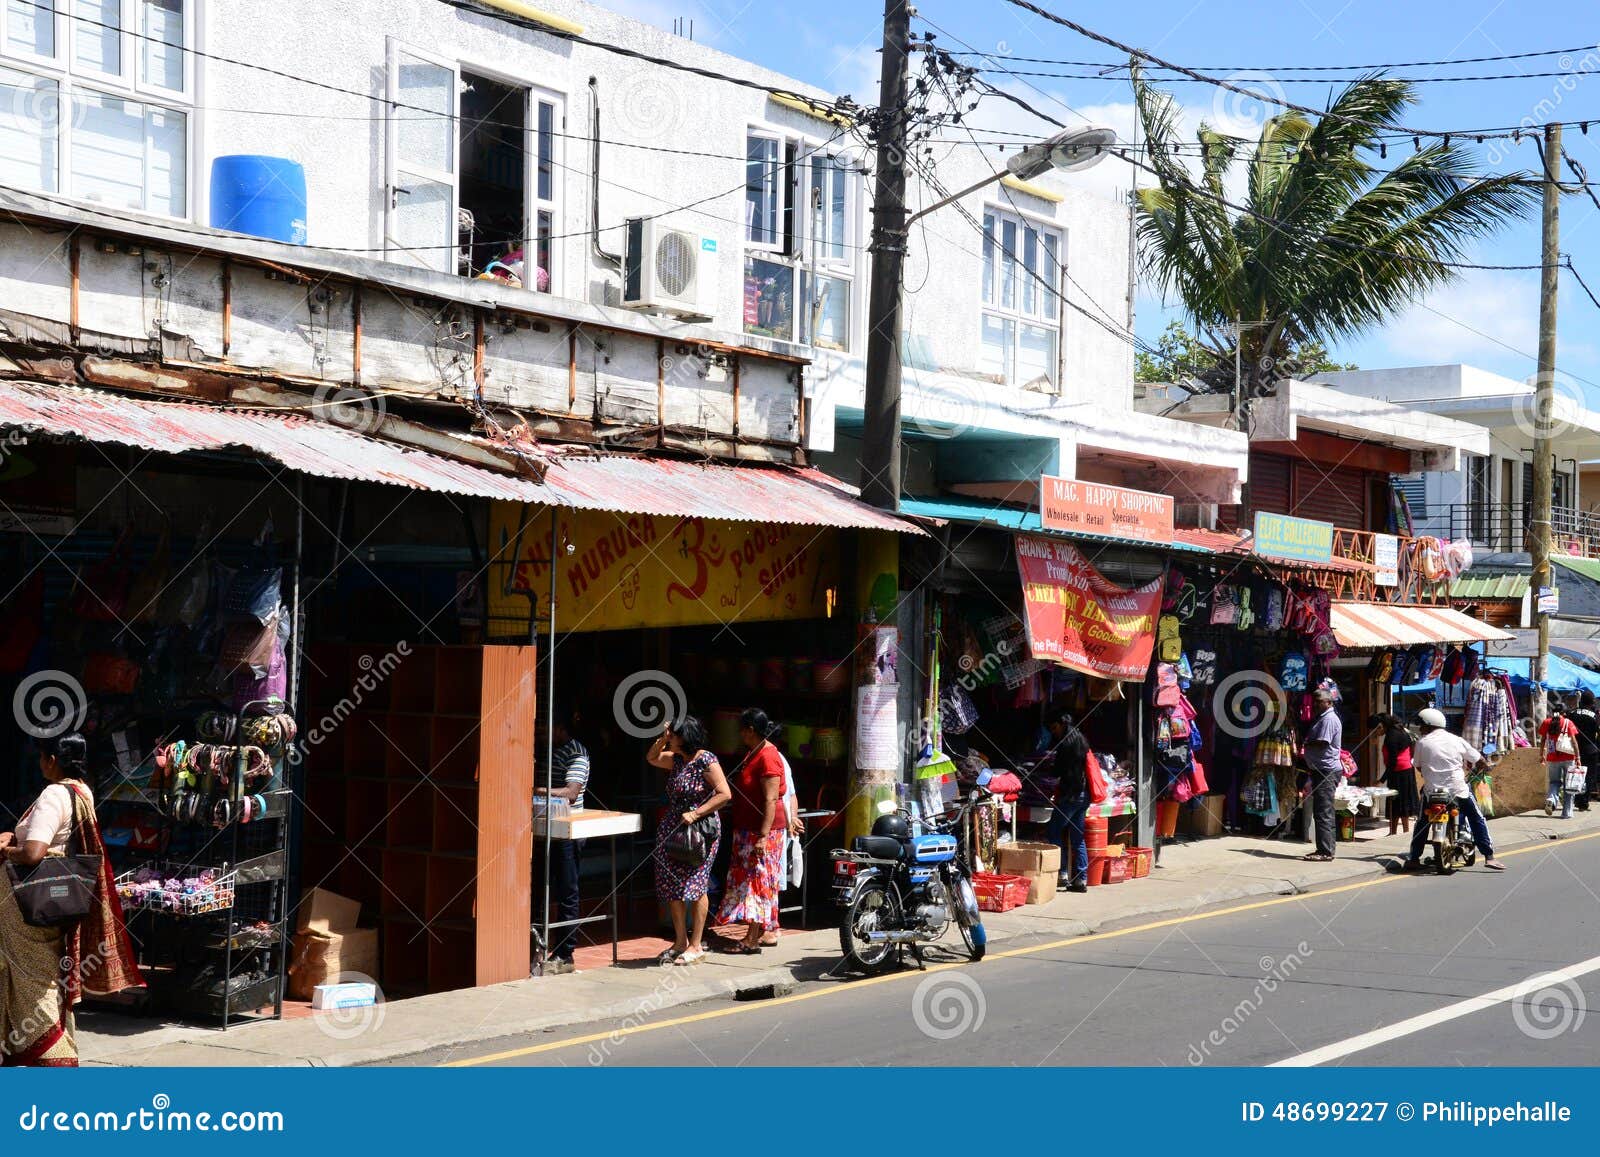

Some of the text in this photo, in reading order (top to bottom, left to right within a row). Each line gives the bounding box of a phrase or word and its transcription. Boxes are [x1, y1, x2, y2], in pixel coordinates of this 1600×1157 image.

[1053, 480, 1165, 514] MAG. HAPPY SHOPPING
[1046, 507, 1079, 523] Wholesale
[1086, 513, 1104, 526] Retail
[567, 514, 658, 598] MURUGA
[1018, 537, 1053, 560] GRANDE
[758, 545, 809, 597] SHOP
